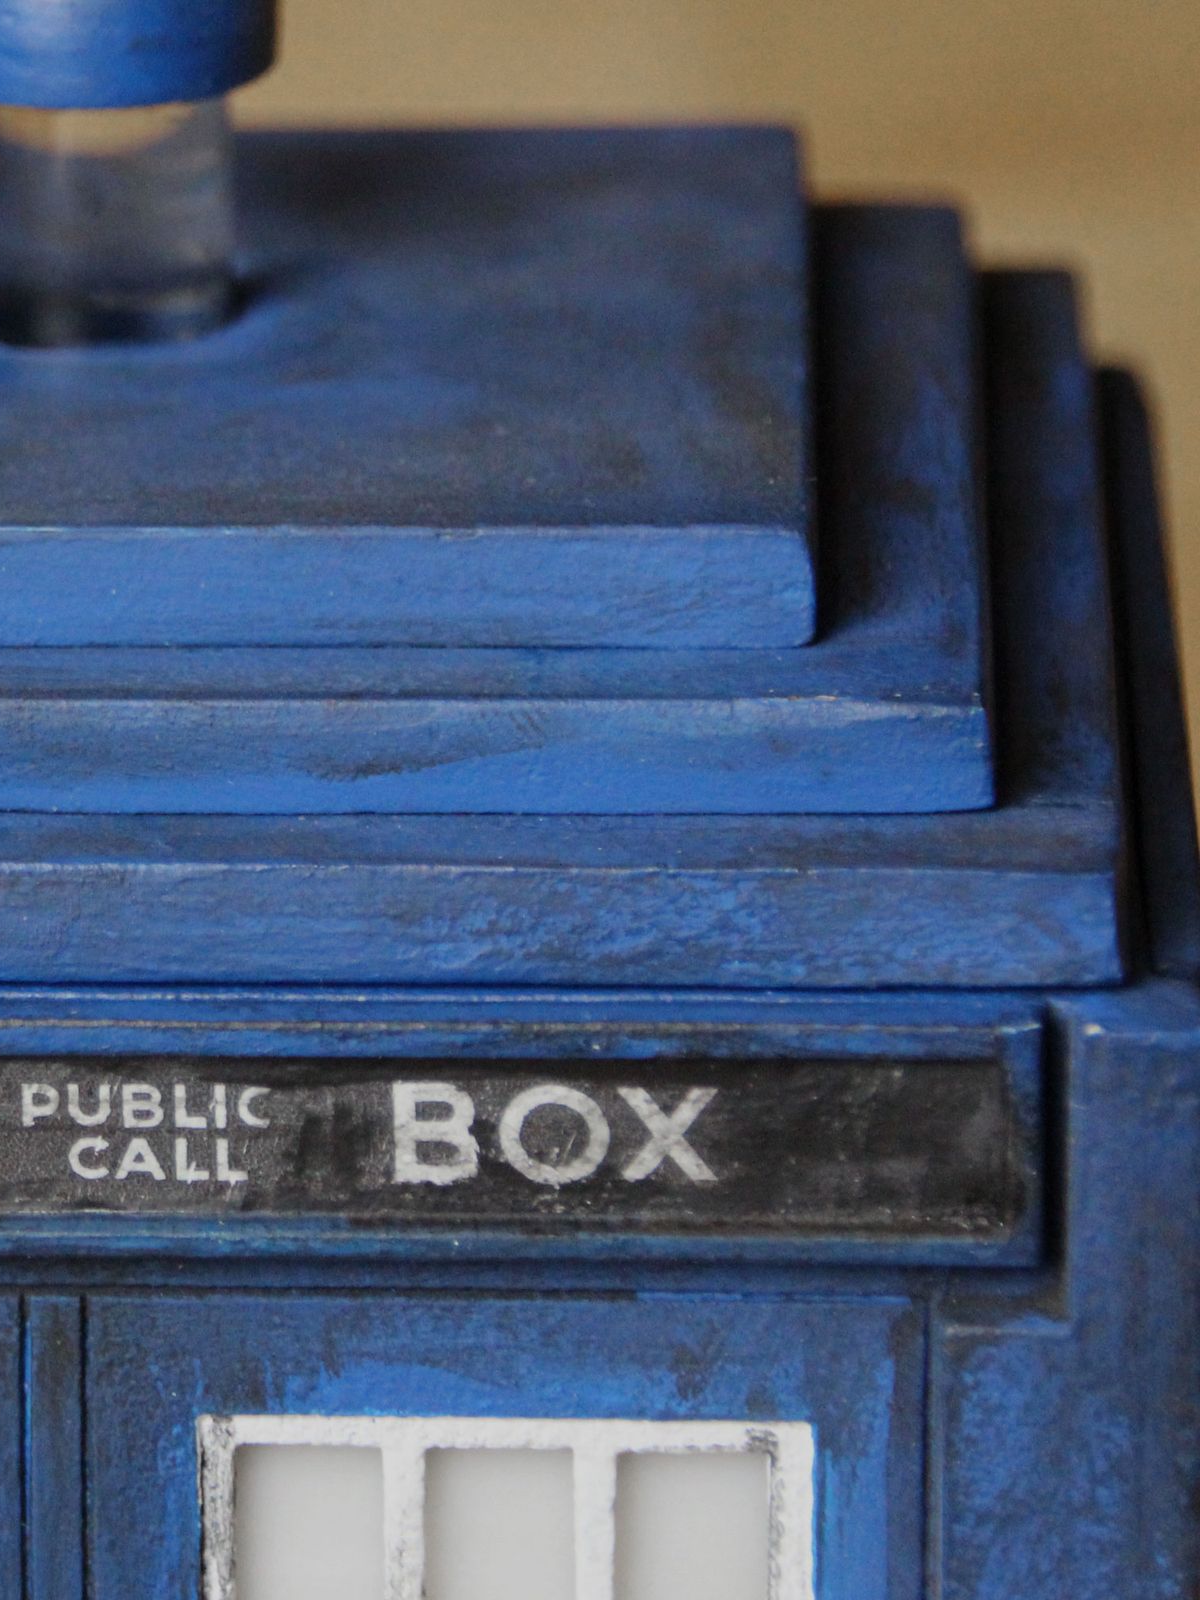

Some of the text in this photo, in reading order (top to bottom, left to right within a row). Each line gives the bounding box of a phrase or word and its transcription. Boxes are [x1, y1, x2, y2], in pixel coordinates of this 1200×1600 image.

[20, 1082, 270, 1129] PUBLIC
[391, 1080, 718, 1188] BOX
[67, 1136, 249, 1186] CALL
